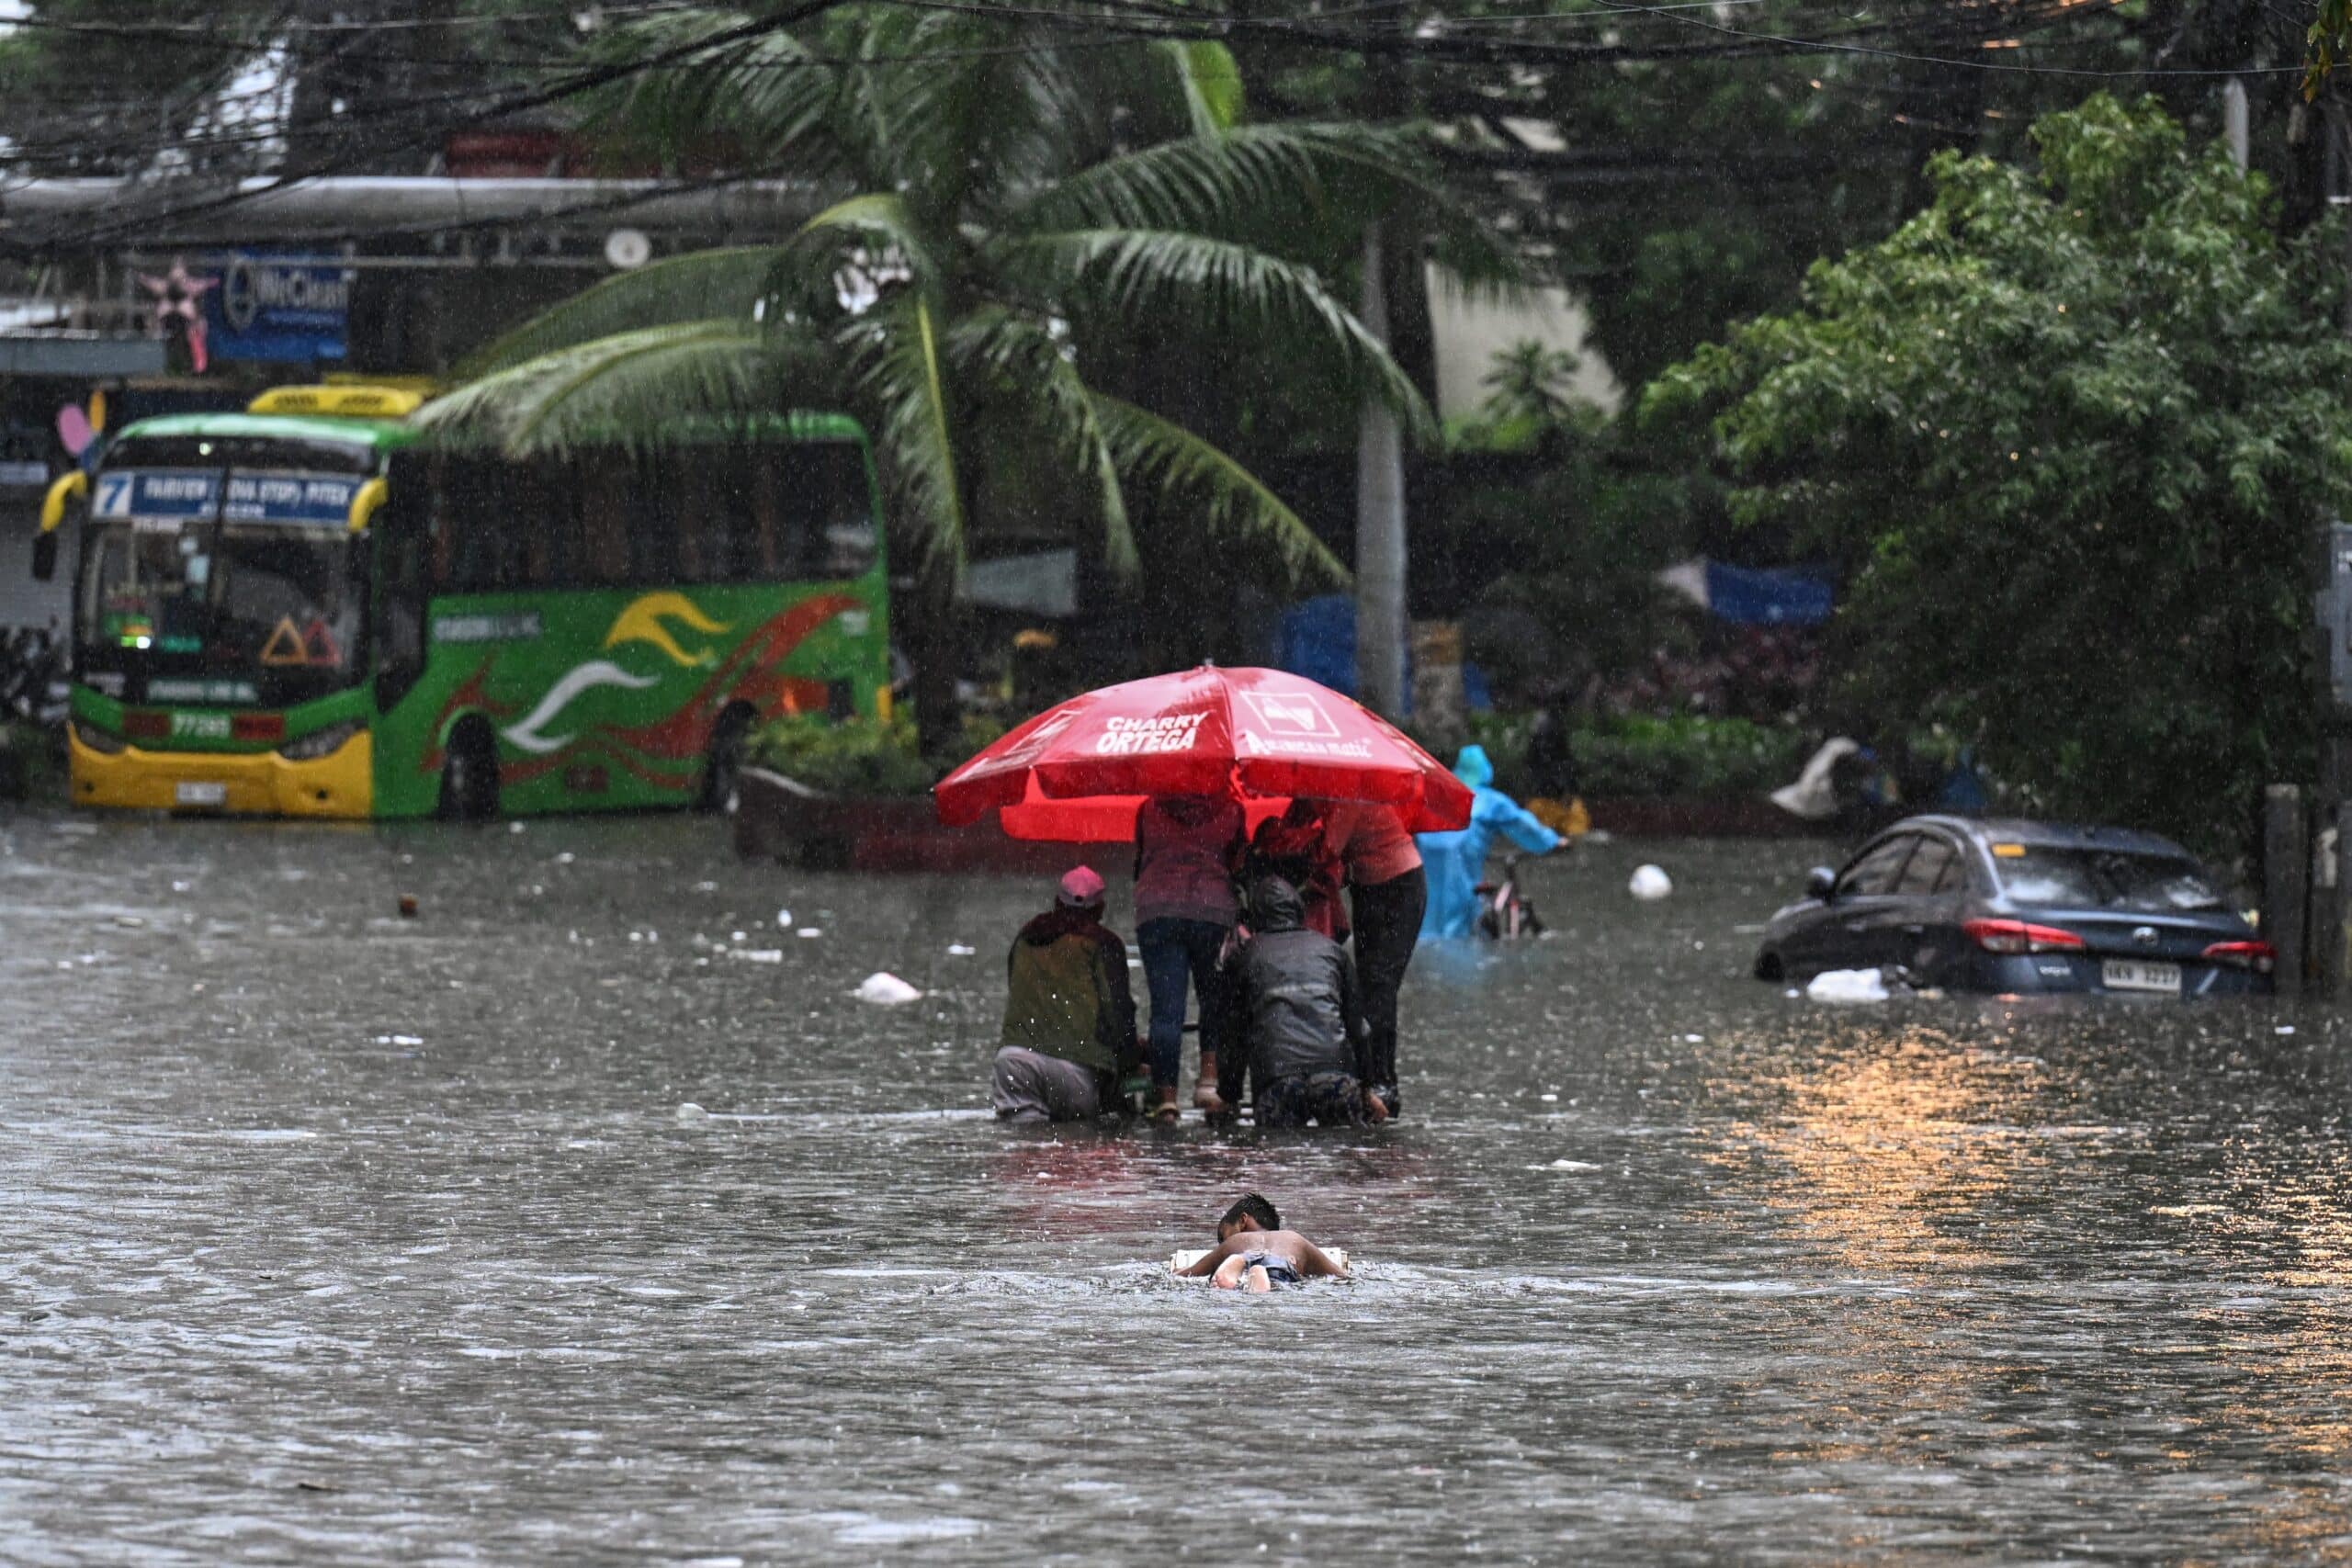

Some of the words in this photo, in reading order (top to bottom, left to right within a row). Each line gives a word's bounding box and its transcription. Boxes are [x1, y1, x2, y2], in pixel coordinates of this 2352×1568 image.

[102, 477, 129, 515] 7
[1107, 711, 1209, 731] CHARRY
[1097, 727, 1197, 753] ORTEGA
